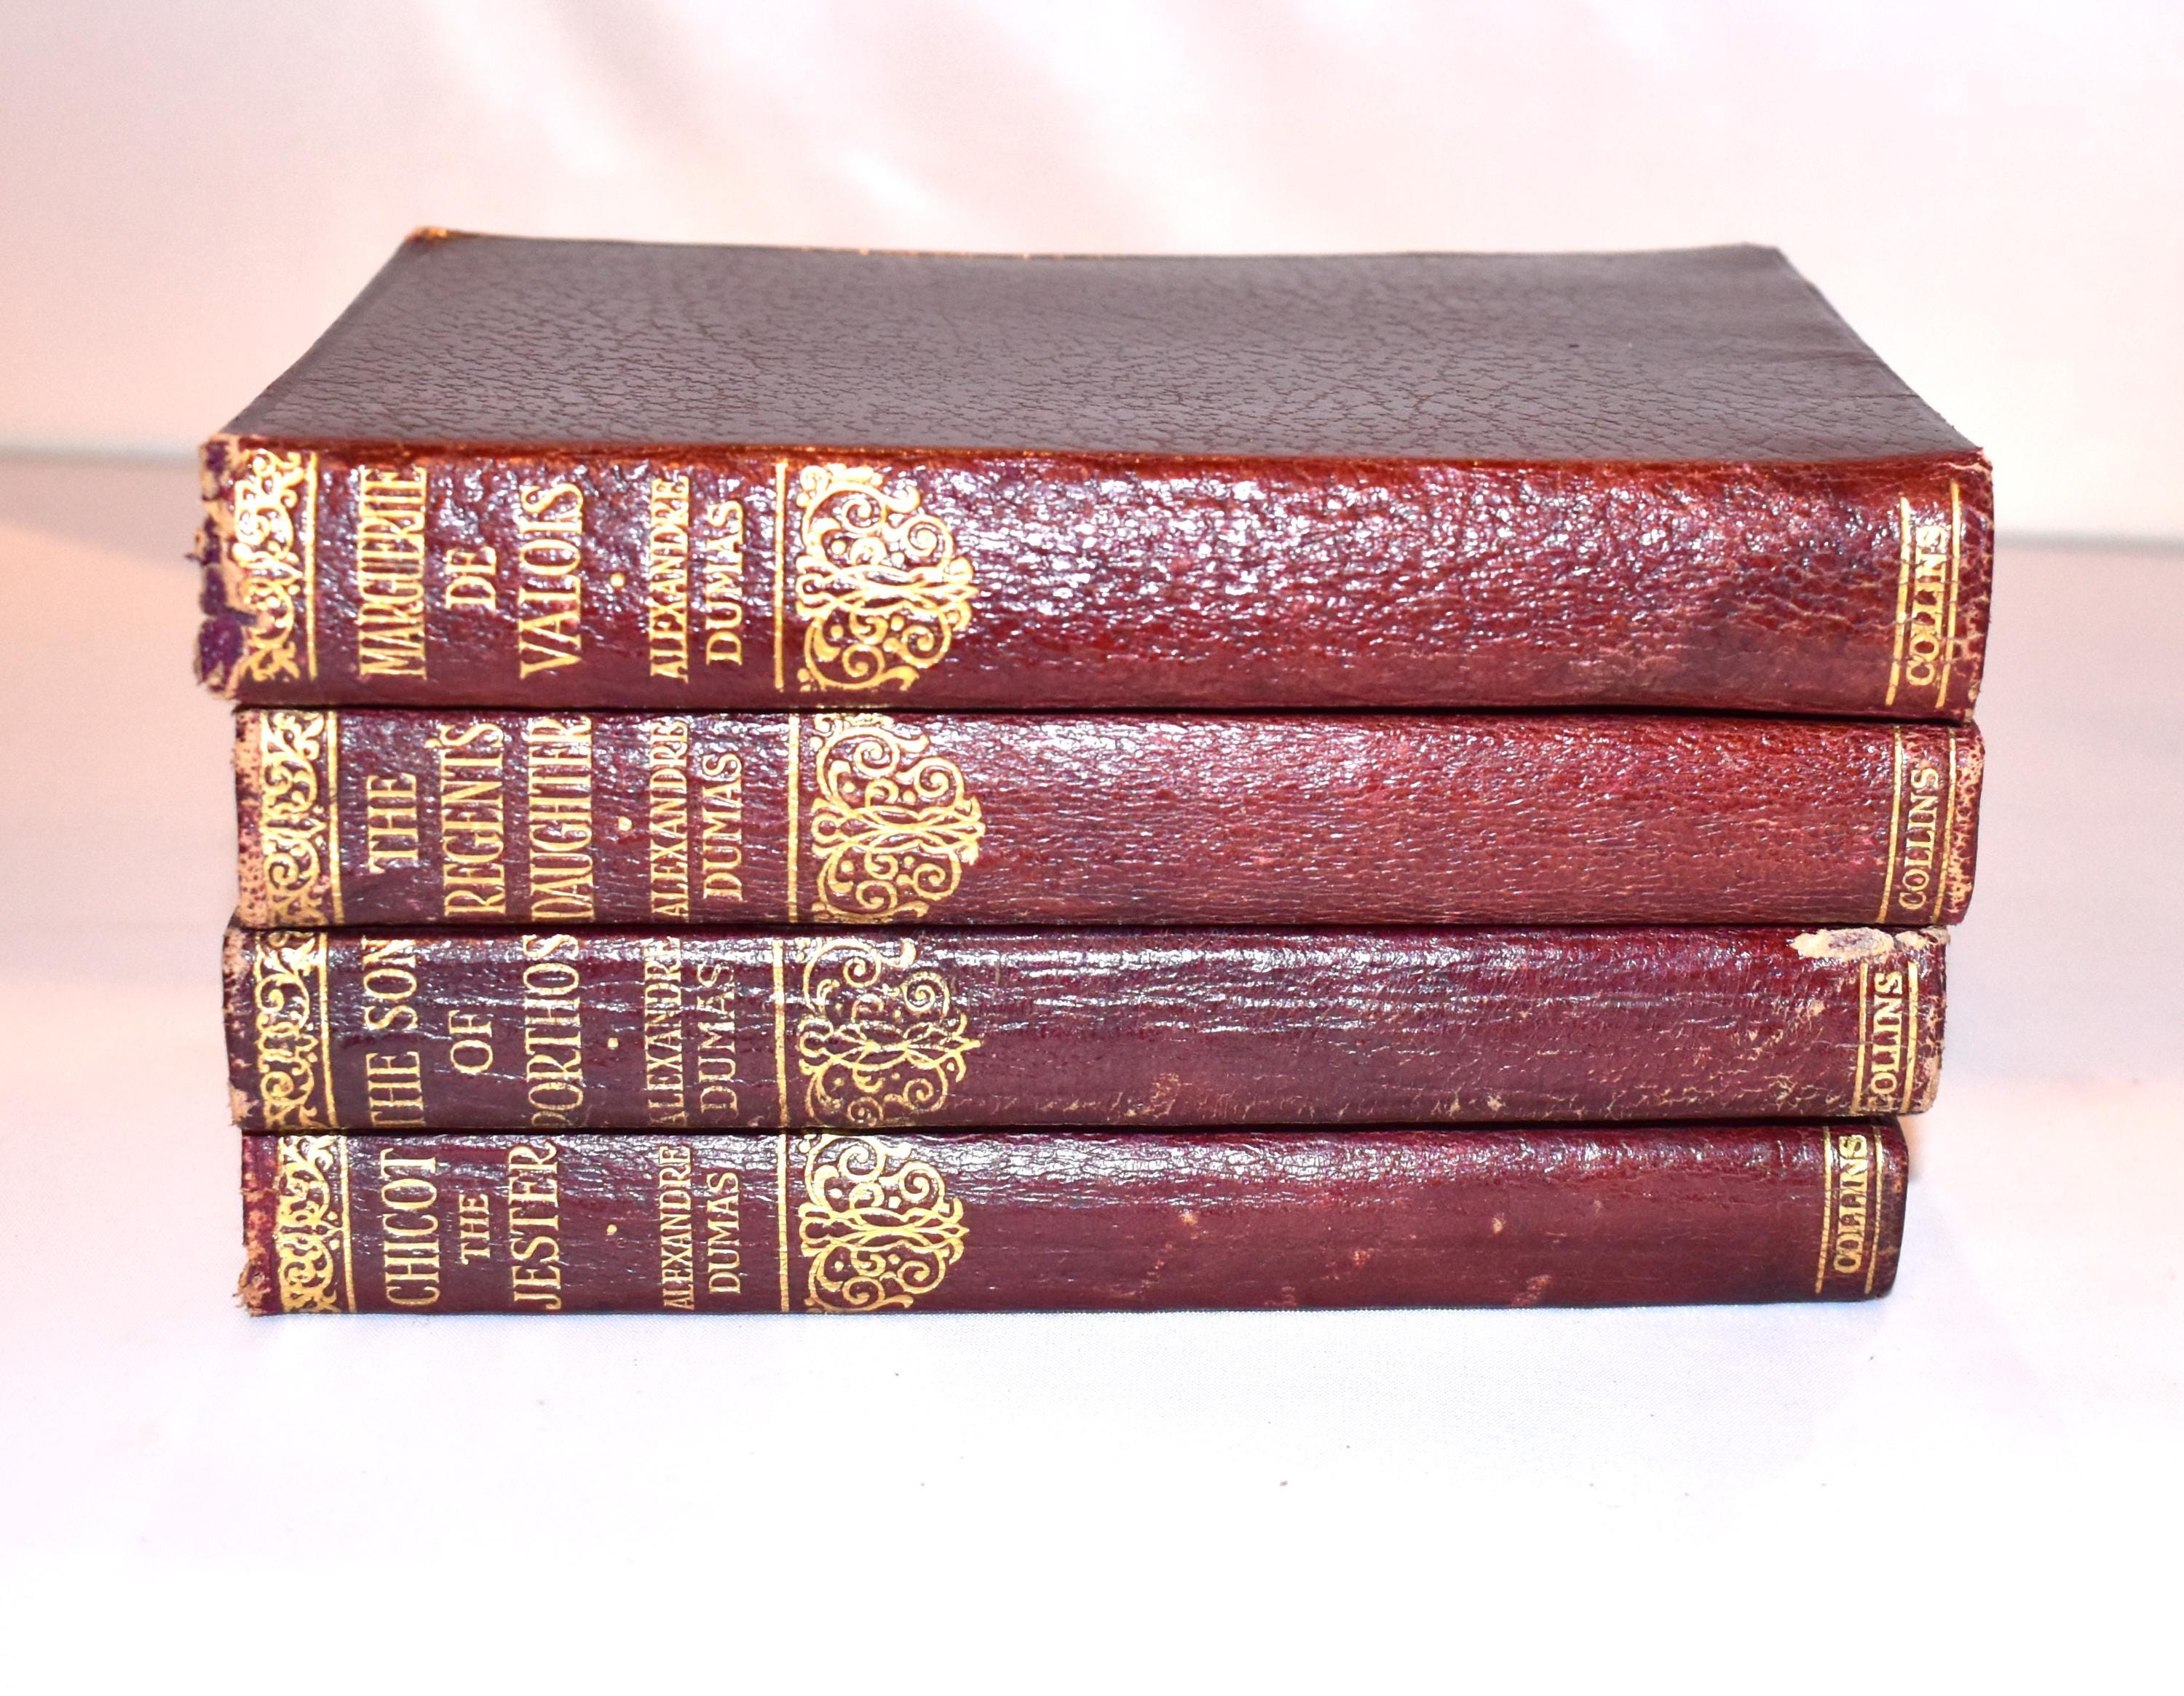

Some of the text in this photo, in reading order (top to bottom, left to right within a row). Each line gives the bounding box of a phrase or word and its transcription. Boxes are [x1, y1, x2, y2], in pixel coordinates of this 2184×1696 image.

[357, 464, 427, 679] MARGUERITE
[446, 545, 496, 610] DE
[518, 481, 584, 679] VALOIS
[649, 475, 690, 683] ALEXANDRE
[706, 499, 744, 665] DUMAS
[1906, 524, 1947, 686] COLLINS
[367, 774, 417, 873] THE
[425, 724, 505, 919] REGENT'S
[529, 715, 594, 922] DAUGHTER
[649, 718, 689, 922] ALEXANDRE
[703, 754, 744, 902] DUMAS
[1899, 766, 1939, 911] COLLINS
[362, 935, 424, 1128] THE SON
[450, 1009, 493, 1074] OF
[644, 937, 688, 1128] ALEXANDRE
[696, 961, 738, 1116] DUMAS
[380, 1148, 440, 1307] CHICOT
[459, 1193, 490, 1265] THE
[508, 1140, 563, 1311] JESTER
[658, 1144, 695, 1312] ALEXANDRE
[707, 1171, 742, 1296] DUMAS
[1832, 1134, 1869, 1274] COLLINS
